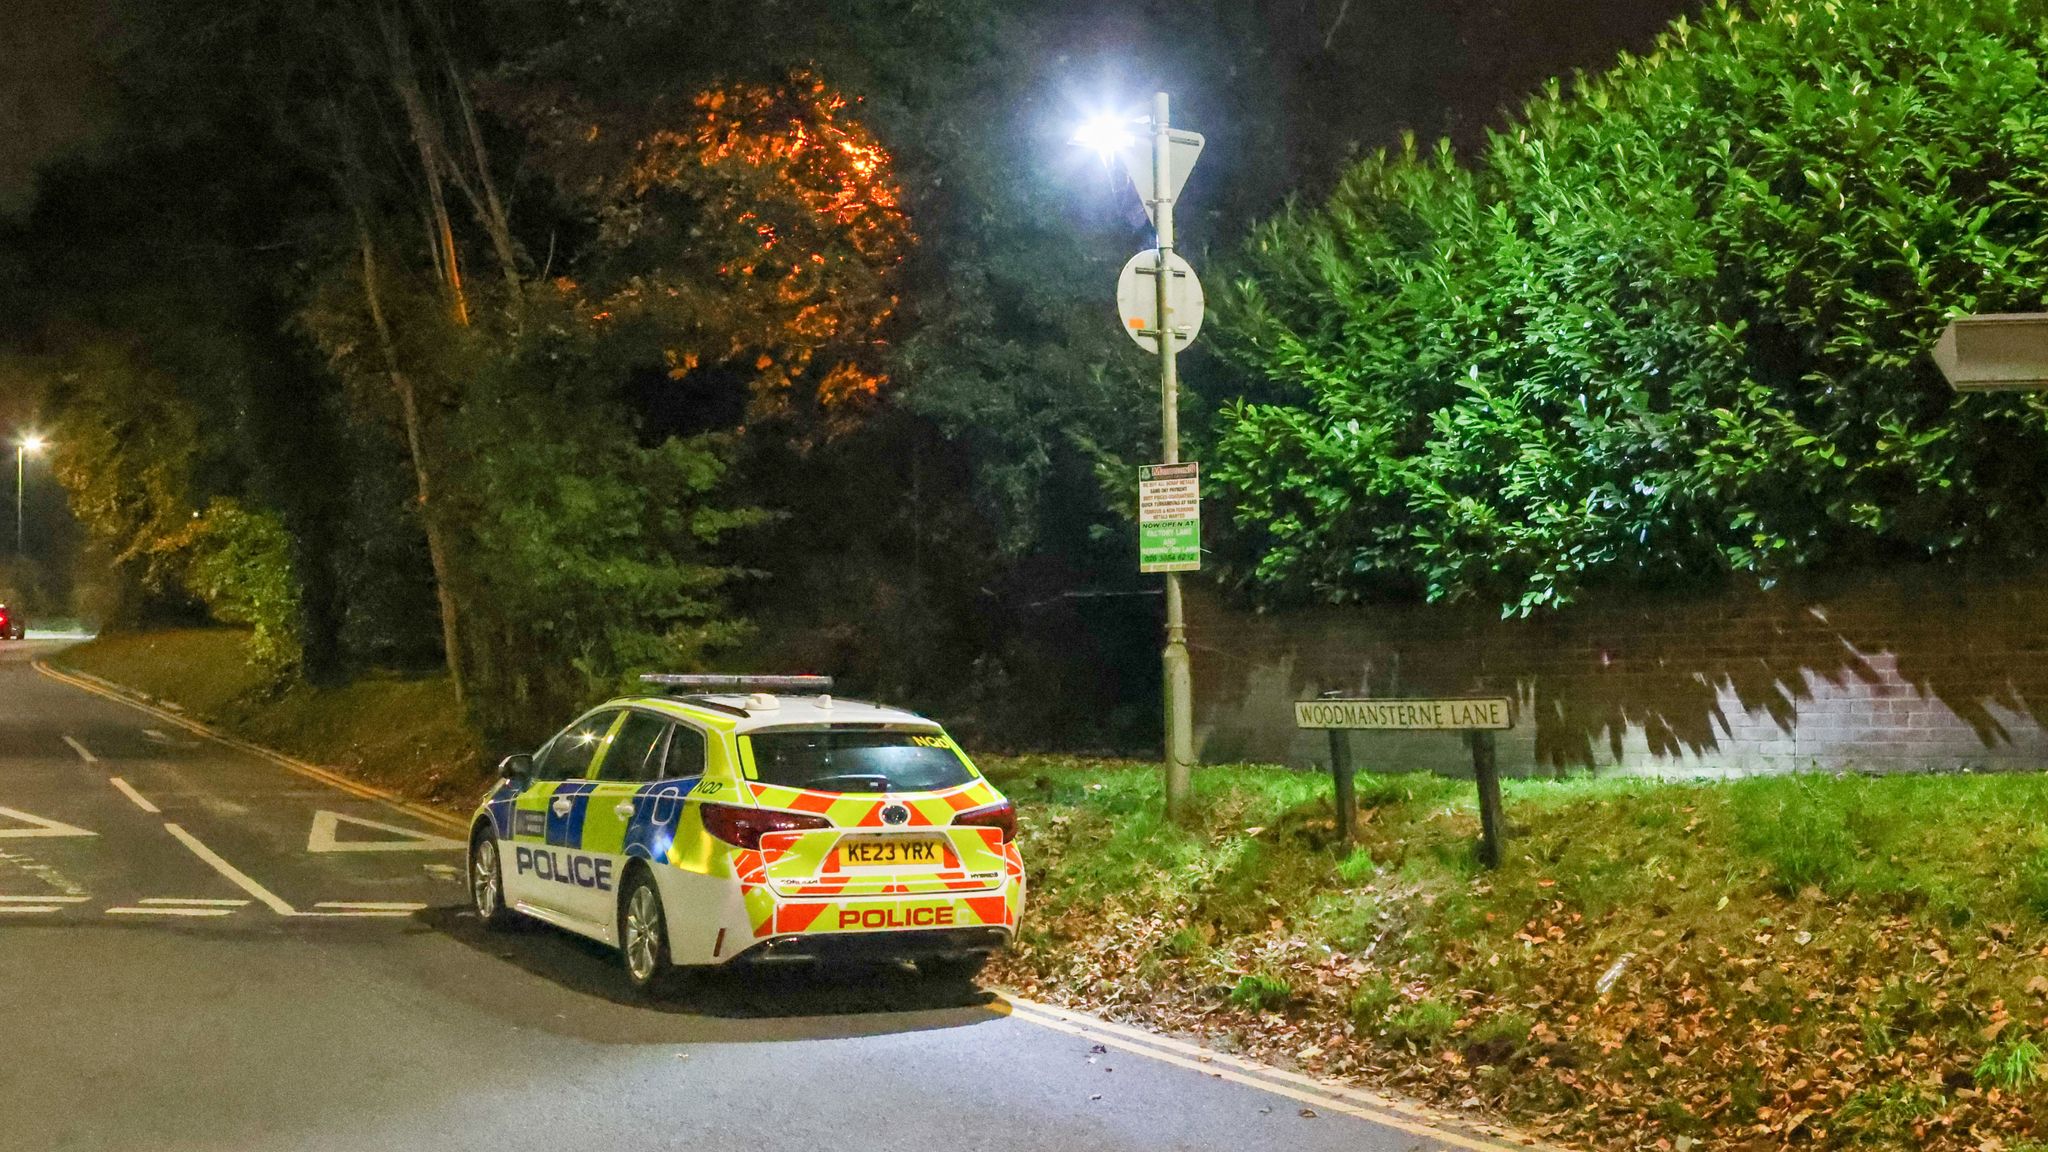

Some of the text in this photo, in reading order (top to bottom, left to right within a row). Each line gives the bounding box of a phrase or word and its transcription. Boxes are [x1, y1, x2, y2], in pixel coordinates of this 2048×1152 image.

[1300, 704, 1499, 726] WOODMANSTERNE LANE
[912, 735, 950, 749] NQD
[691, 780, 723, 794] NQD
[848, 841, 936, 862] KE23 YRX
[516, 846, 612, 891] POLICE
[838, 906, 954, 929] POLICE
